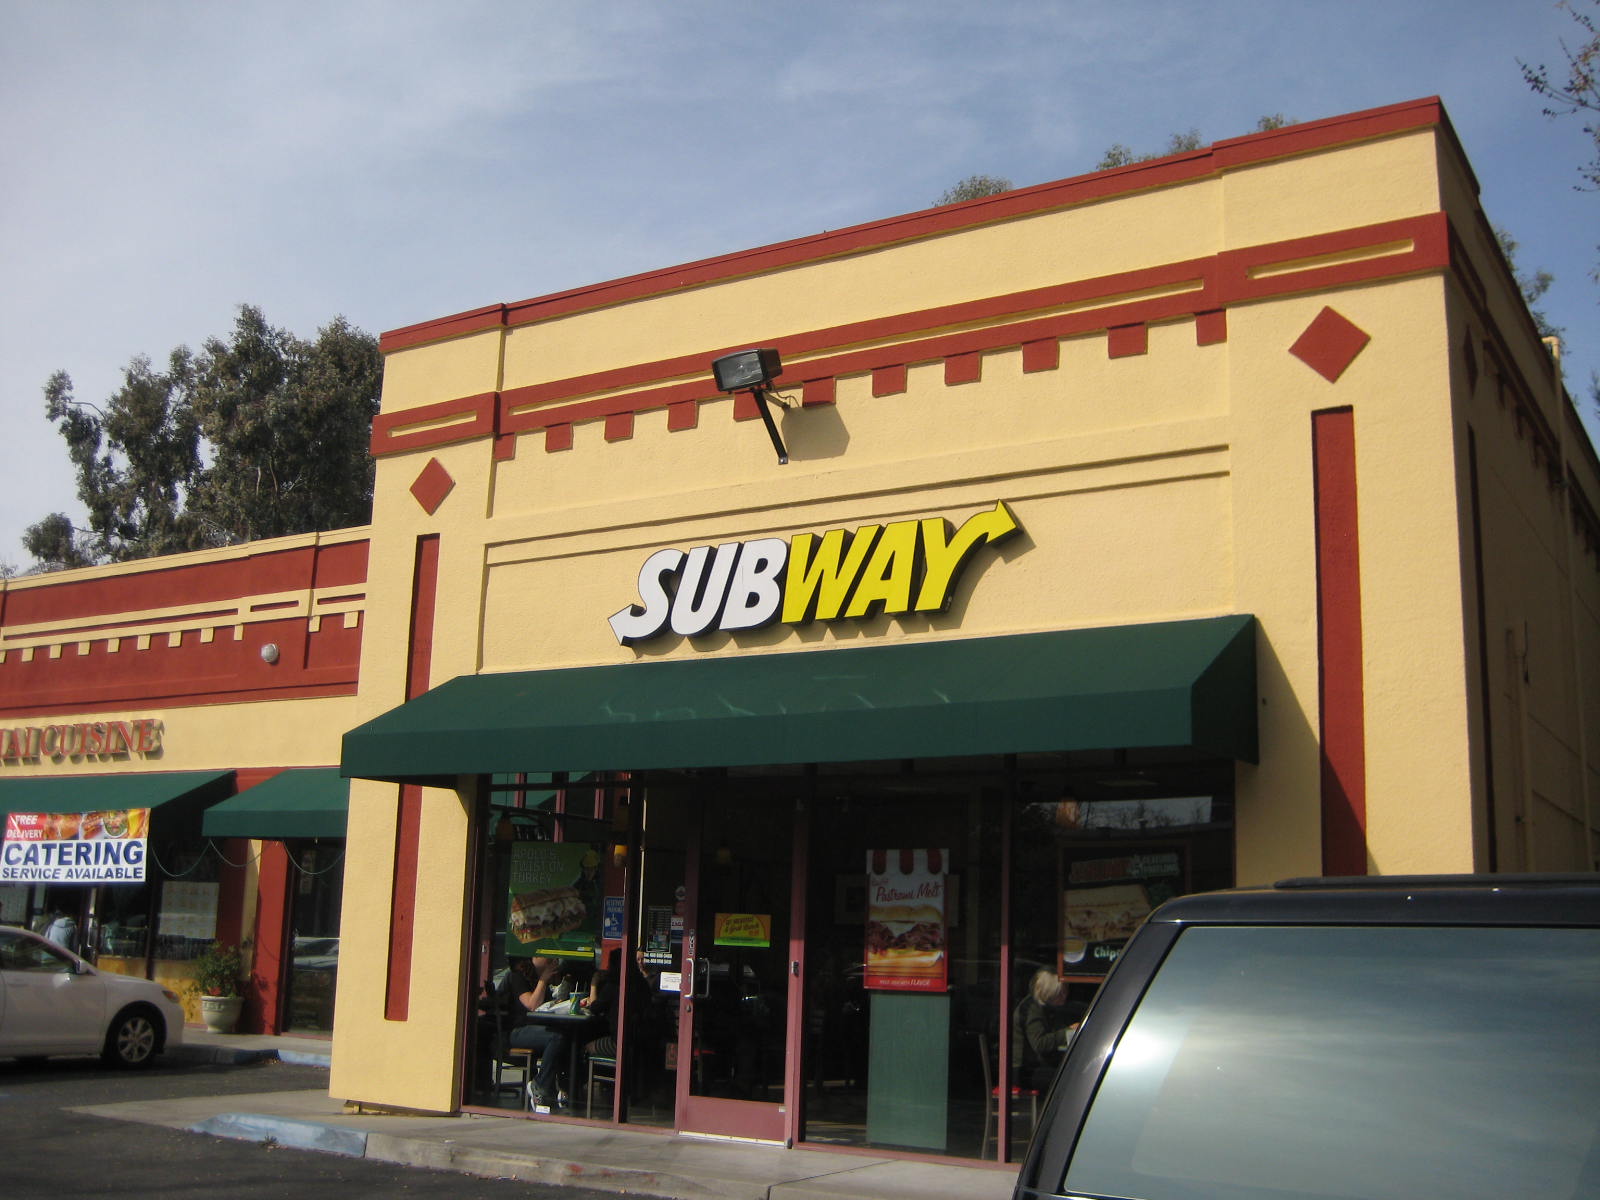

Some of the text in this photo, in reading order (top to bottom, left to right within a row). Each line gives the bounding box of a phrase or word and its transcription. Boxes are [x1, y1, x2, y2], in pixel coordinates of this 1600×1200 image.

[608, 499, 1018, 646] SUBWAY
[40, 718, 163, 757] CUISINE
[14, 815, 38, 825] FREE
[6, 829, 43, 839] DELIVERY
[4, 840, 144, 866] CATERING
[2, 867, 143, 880] SERVICE AVAILABLE
